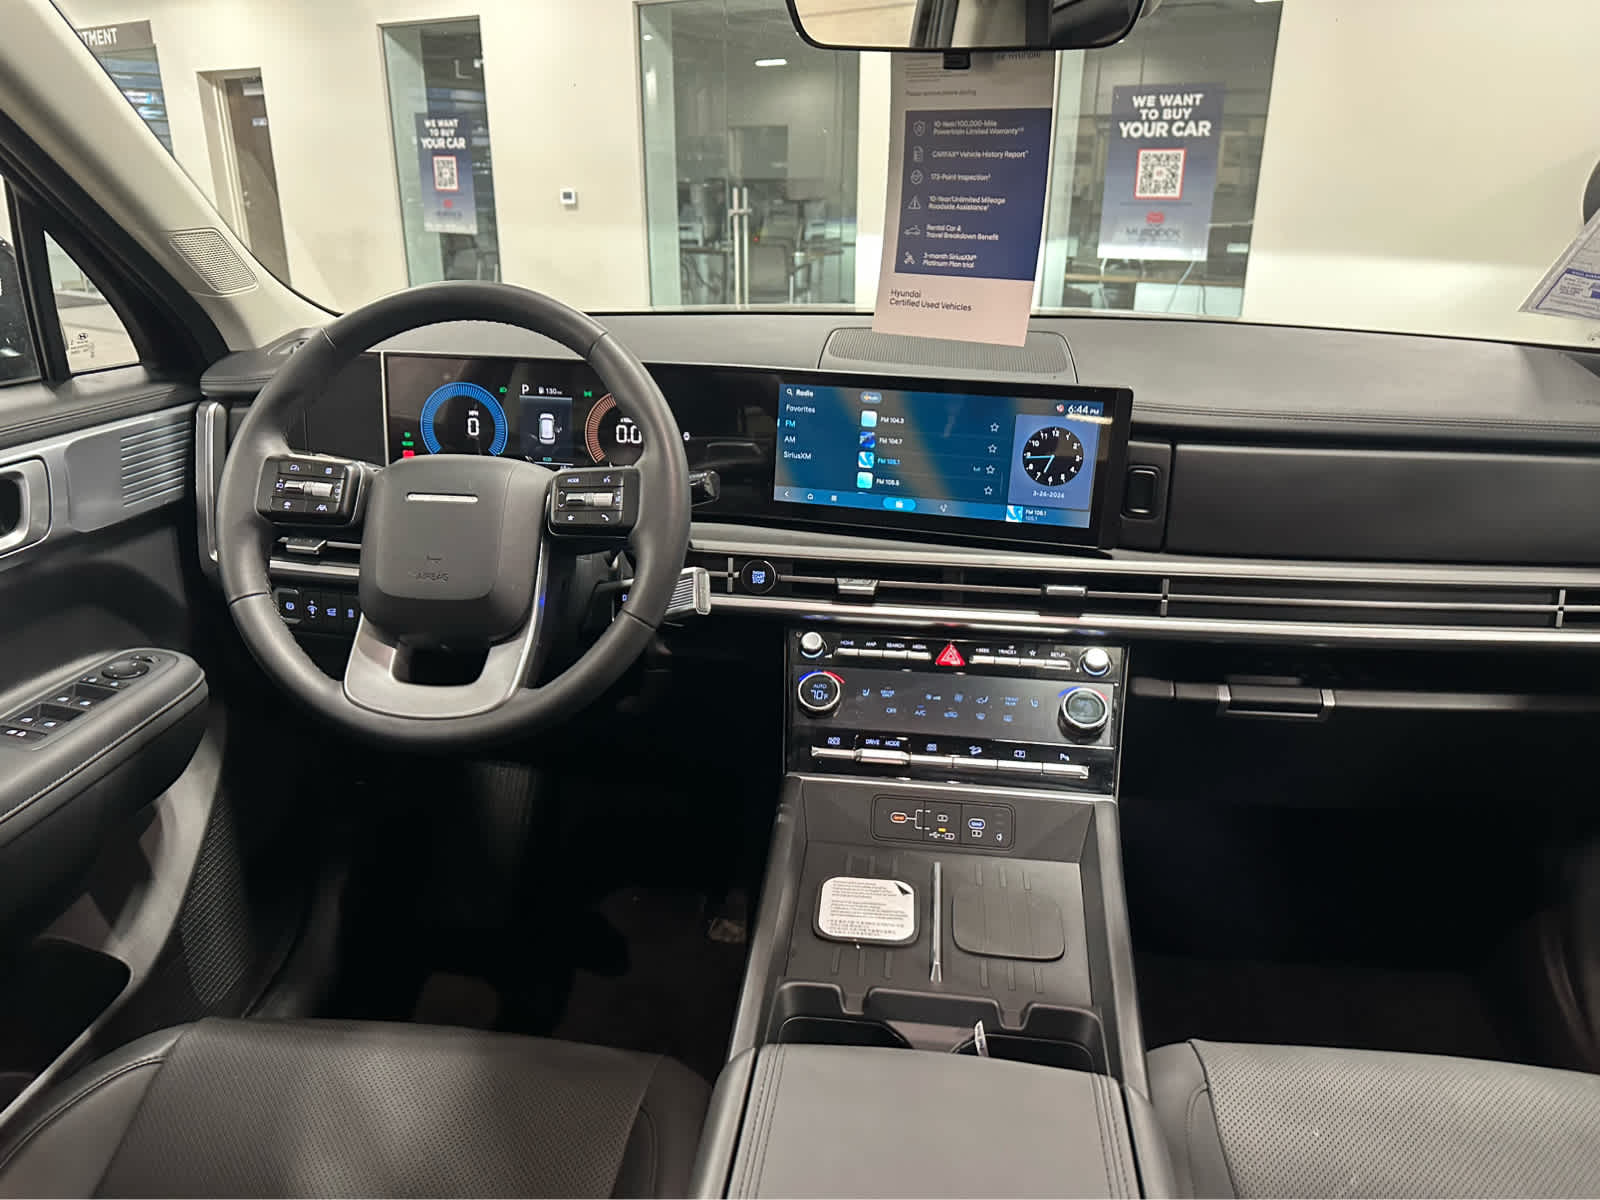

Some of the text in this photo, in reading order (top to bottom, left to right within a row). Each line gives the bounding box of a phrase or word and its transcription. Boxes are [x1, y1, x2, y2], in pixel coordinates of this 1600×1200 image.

[78, 28, 118, 46] TMENT
[1132, 93, 1204, 108] WE WANT
[1139, 108, 1193, 120] TO BUY
[424, 119, 459, 128] WE WANT
[430, 129, 455, 137] TO BUY
[1119, 120, 1212, 138] YOUR CAR
[420, 138, 466, 150] YOUR CAR
[960, 150, 981, 158] Vehicle
[982, 150, 1004, 159] History
[981, 196, 1006, 206] Mileage
[926, 224, 945, 232] Rental
[945, 224, 956, 232] Car
[926, 231, 999, 241] Travel Breakdown Benefit
[922, 259, 948, 267] Platinum
[948, 260, 962, 268] Plan
[890, 289, 921, 299] Hyundai
[889, 297, 972, 311] Certified Used Vehicles
[521, 383, 530, 395] P
[796, 389, 814, 397] Radio
[786, 404, 816, 414] Favorites
[1067, 404, 1089, 415] 6:44
[785, 419, 796, 428] FM
[784, 436, 796, 444] AM
[783, 451, 812, 460] SiriusXM
